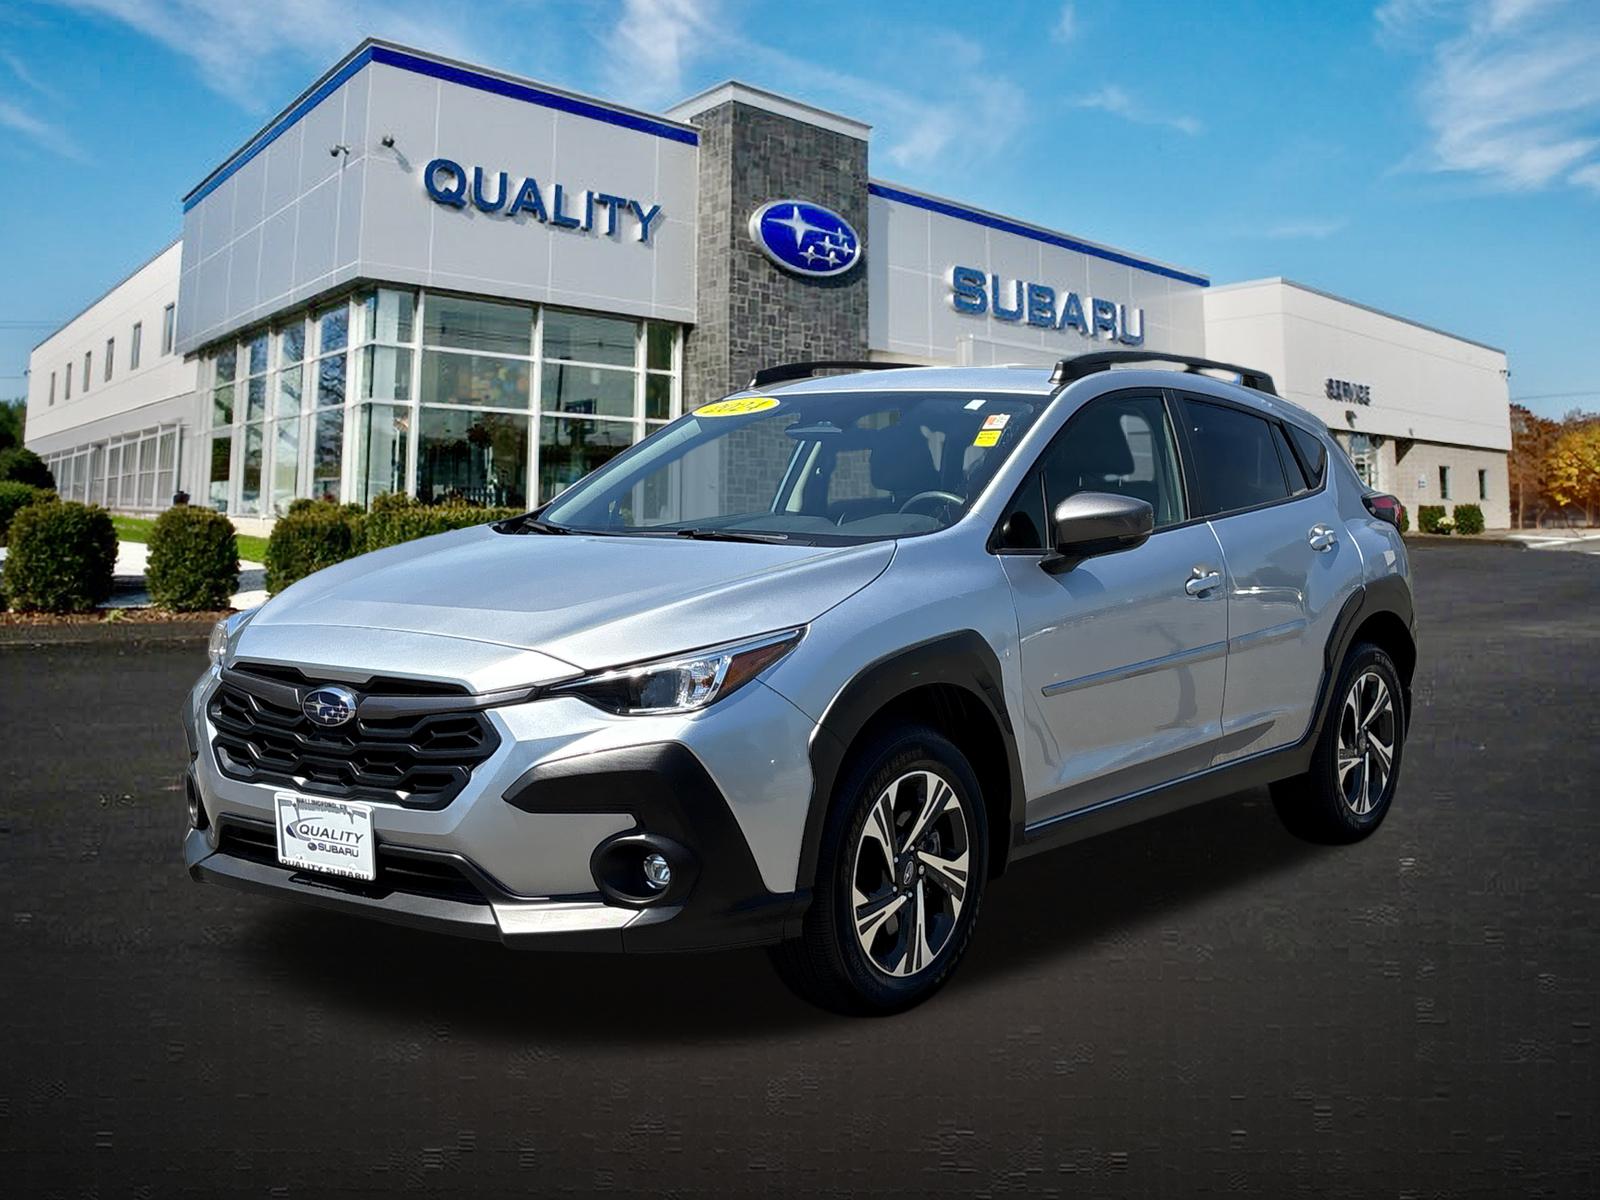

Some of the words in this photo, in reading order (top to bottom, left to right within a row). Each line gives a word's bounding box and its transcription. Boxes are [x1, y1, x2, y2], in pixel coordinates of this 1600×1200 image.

[424, 158, 661, 242] QUALITY
[950, 265, 1144, 346] SUBARU
[1324, 378, 1370, 406] SERVICE
[299, 824, 364, 843] QUALITY
[318, 843, 359, 857] SUBARU
[281, 858, 323, 872] QUALITY
[327, 866, 370, 880] SUBARU
